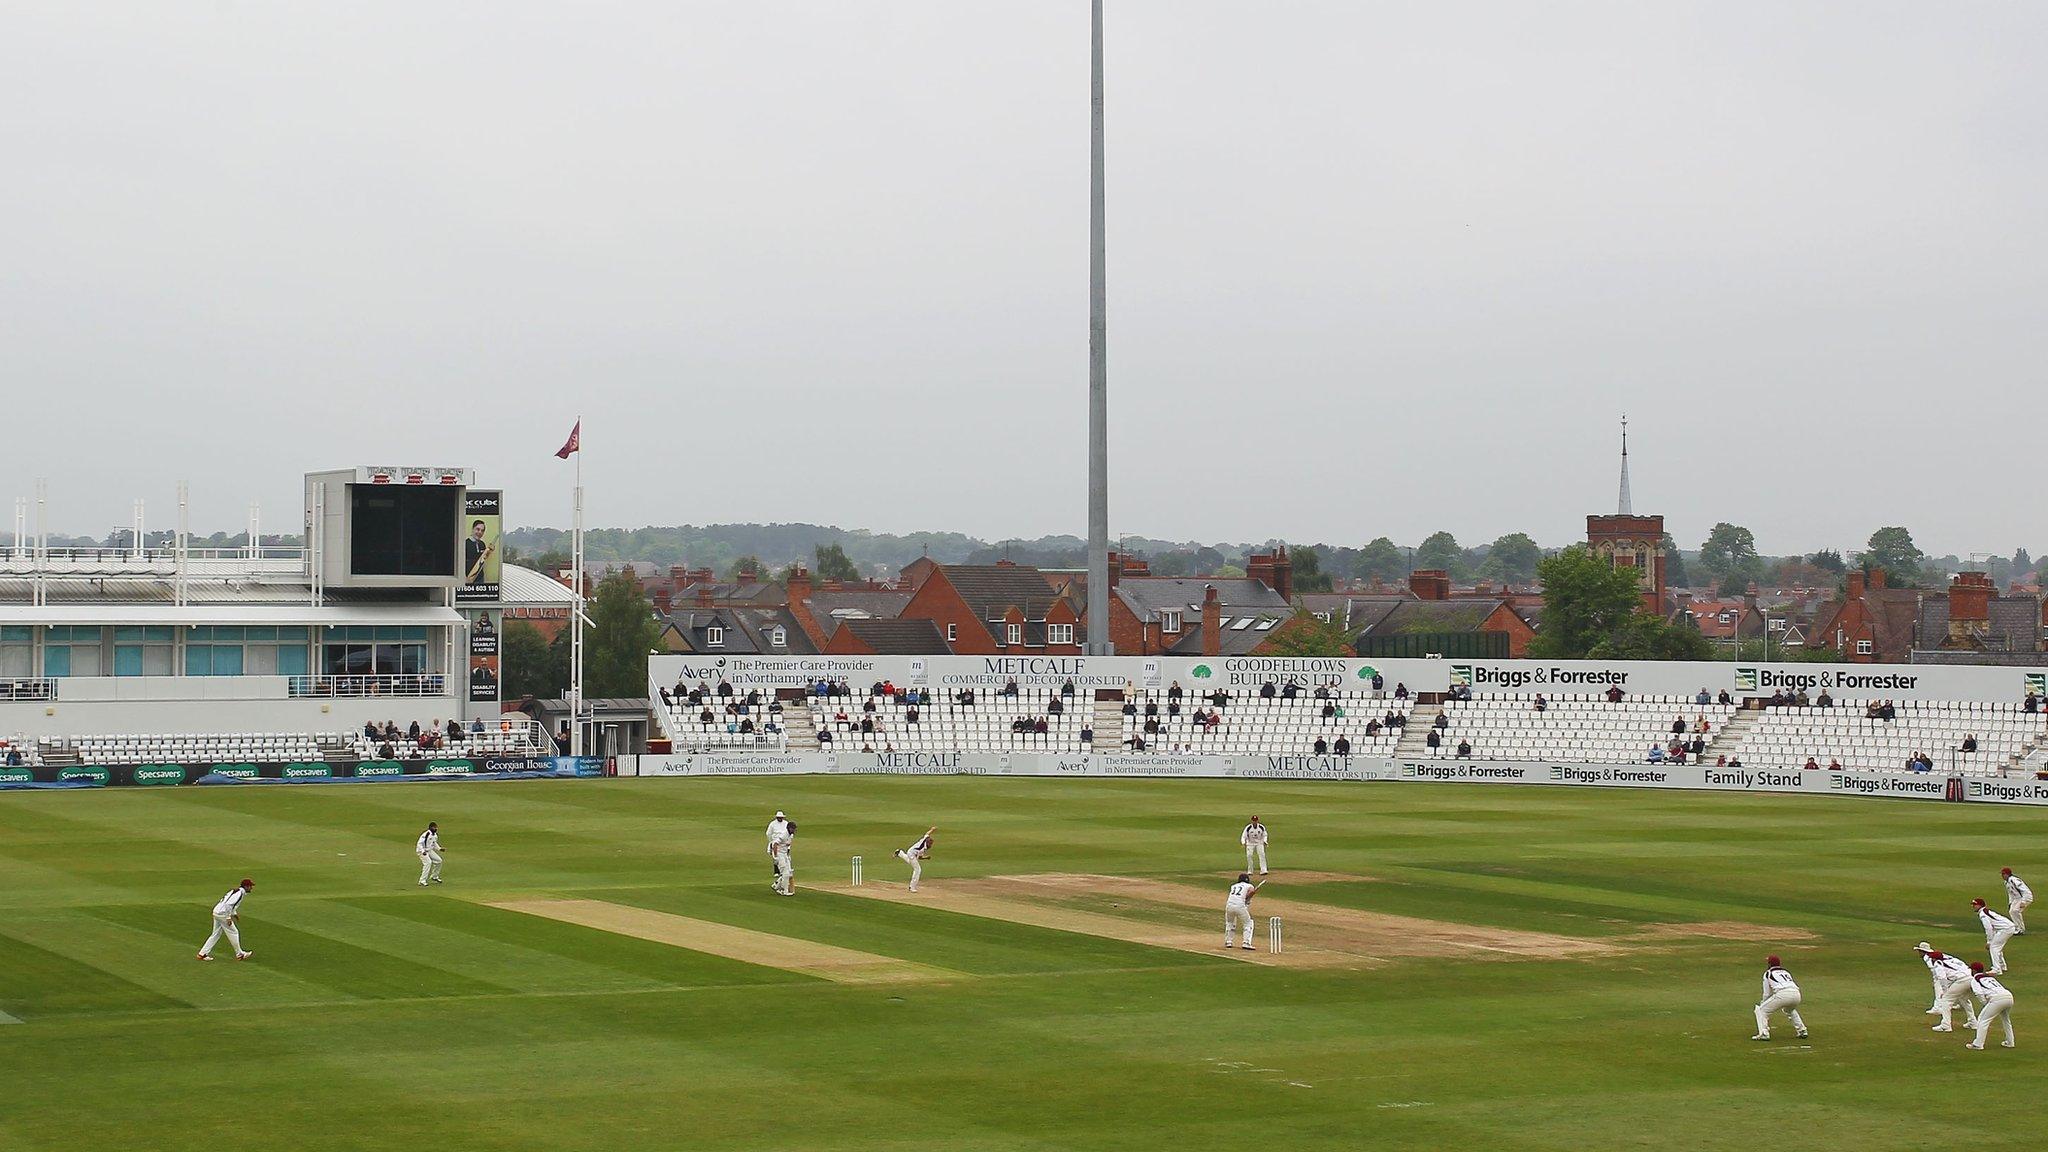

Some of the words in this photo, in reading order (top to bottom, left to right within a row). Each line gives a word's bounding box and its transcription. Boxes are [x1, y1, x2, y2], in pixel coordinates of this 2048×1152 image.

[732, 660, 752, 670] The
[755, 660, 798, 670] Premier
[800, 660, 824, 670] Care
[828, 660, 874, 670] Provider
[985, 658, 1086, 675] METCALF
[1226, 659, 1346, 672] GOODFELLOWS
[679, 664, 726, 683] Avery
[732, 674, 742, 683] in
[745, 673, 848, 685] Northamptonshire
[1230, 673, 1308, 685] BUILDERS
[1314, 674, 1342, 686] LTD
[1476, 667, 1531, 687] Briggs
[1534, 668, 1547, 684] &
[1551, 668, 1628, 685] Forrester
[942, 675, 1023, 686] COMMERCIAL
[1026, 675, 1102, 686] DECORATORS
[1104, 676, 1126, 686] LTD
[1761, 670, 1816, 691] Briggs
[1820, 671, 1832, 687] &
[1836, 672, 1917, 689] Forrester
[486, 760, 524, 773] Georgian
[527, 760, 552, 769] House
[877, 754, 960, 767] METCALF
[1057, 760, 1089, 774] Avery
[1171, 758, 1202, 766] Provider
[1268, 757, 1358, 771] METCALF
[139, 769, 181, 780] Specsavers
[286, 768, 327, 778] Specsavers
[358, 766, 399, 776] Specsavers
[662, 762, 692, 774] Avery
[716, 766, 784, 774] Northamptonshire
[1114, 766, 1186, 775] Northamptonshire
[1418, 764, 1456, 779] Briggs
[1458, 765, 1467, 776] &
[1469, 766, 1525, 778] Forrester
[1564, 767, 1601, 782] Briggs
[1603, 768, 1612, 780] &
[1614, 769, 1667, 782] Forrester
[1705, 770, 1753, 788] Family
[1758, 773, 1801, 786] Stand
[1844, 776, 1879, 792] Briggs
[1881, 778, 1889, 790] &
[1892, 779, 1942, 794] Forrester
[1984, 784, 2021, 800] Briggs
[2023, 785, 2032, 798] &
[2035, 786, 2048, 798] Fo
